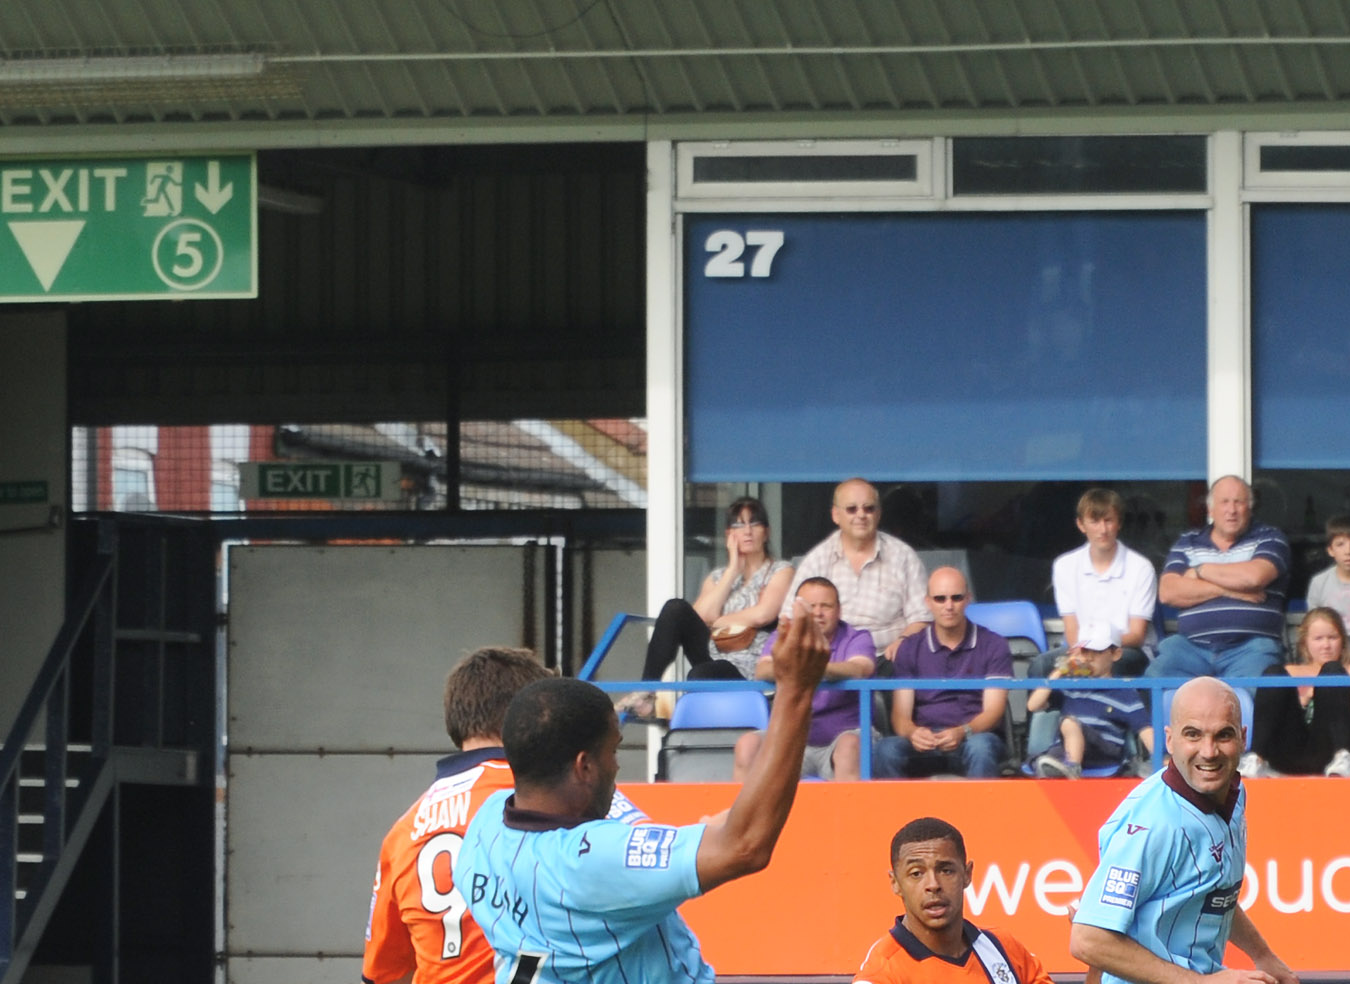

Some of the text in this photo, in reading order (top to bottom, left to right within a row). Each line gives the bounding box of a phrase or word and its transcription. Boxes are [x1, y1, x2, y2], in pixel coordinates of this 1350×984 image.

[2, 167, 127, 212] EXIT
[172, 233, 202, 277] 5
[705, 230, 783, 277] 27
[267, 468, 333, 493] EXIT
[410, 791, 472, 841] SHAW
[628, 829, 648, 866] BLUE
[642, 841, 659, 867] SQ
[416, 832, 468, 960] 9
[965, 860, 1086, 917] we
[1105, 880, 1125, 895] SQ
[1109, 868, 1139, 885] BLUE
